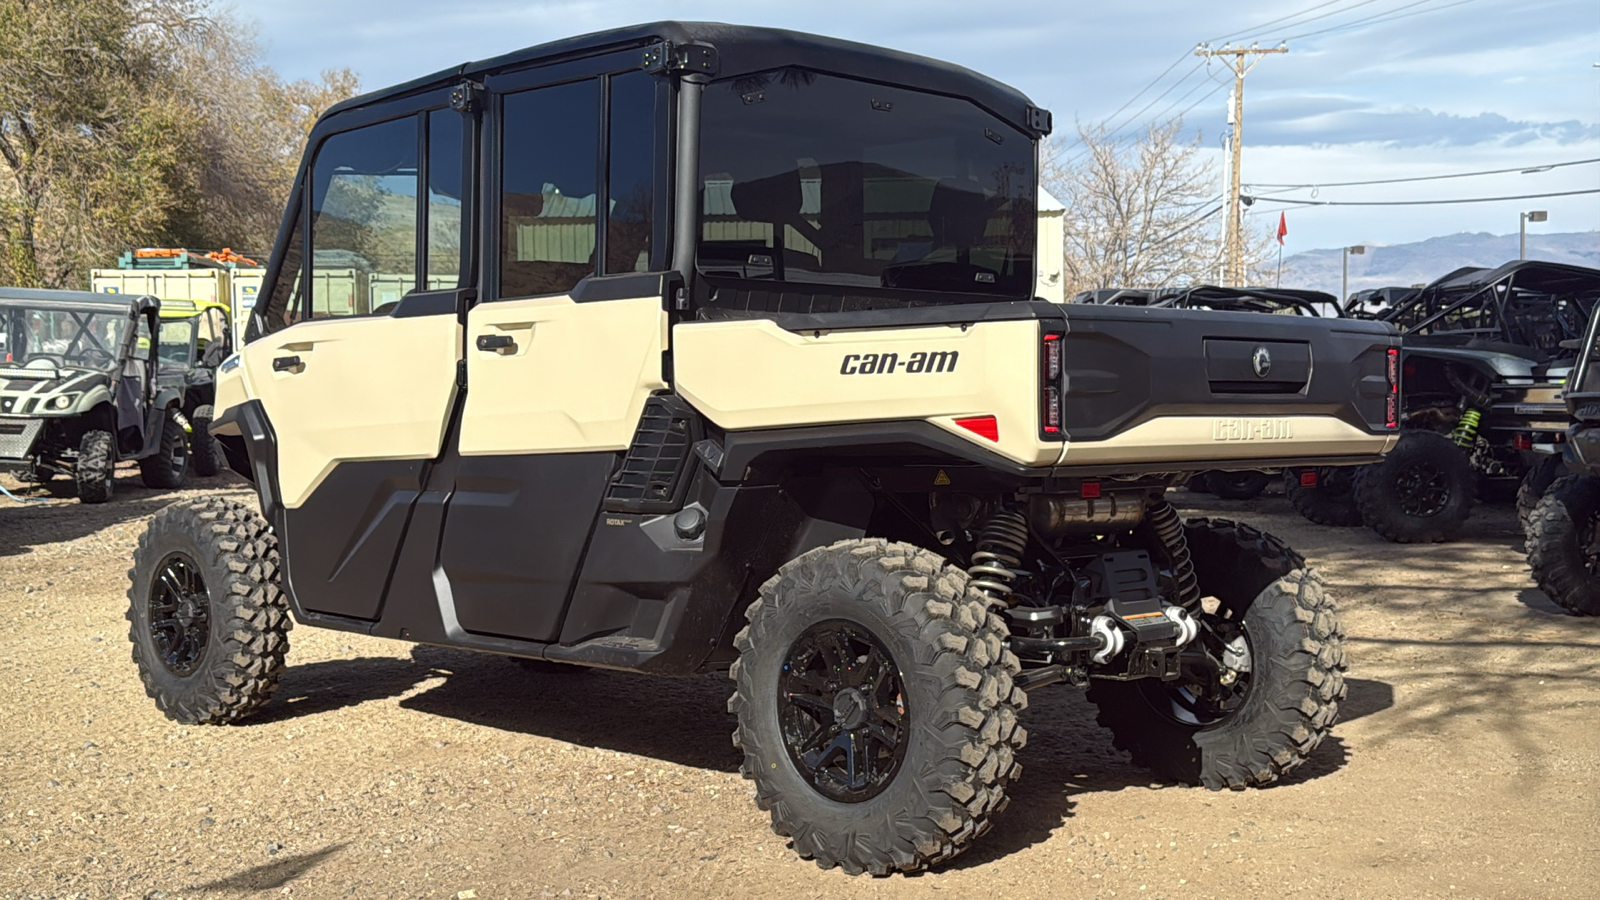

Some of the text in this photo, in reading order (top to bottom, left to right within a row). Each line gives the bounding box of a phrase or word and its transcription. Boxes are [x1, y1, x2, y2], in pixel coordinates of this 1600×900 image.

[840, 350, 959, 375] can-am
[1213, 418, 1293, 440] can-am
[606, 518, 625, 526] ROTAX
